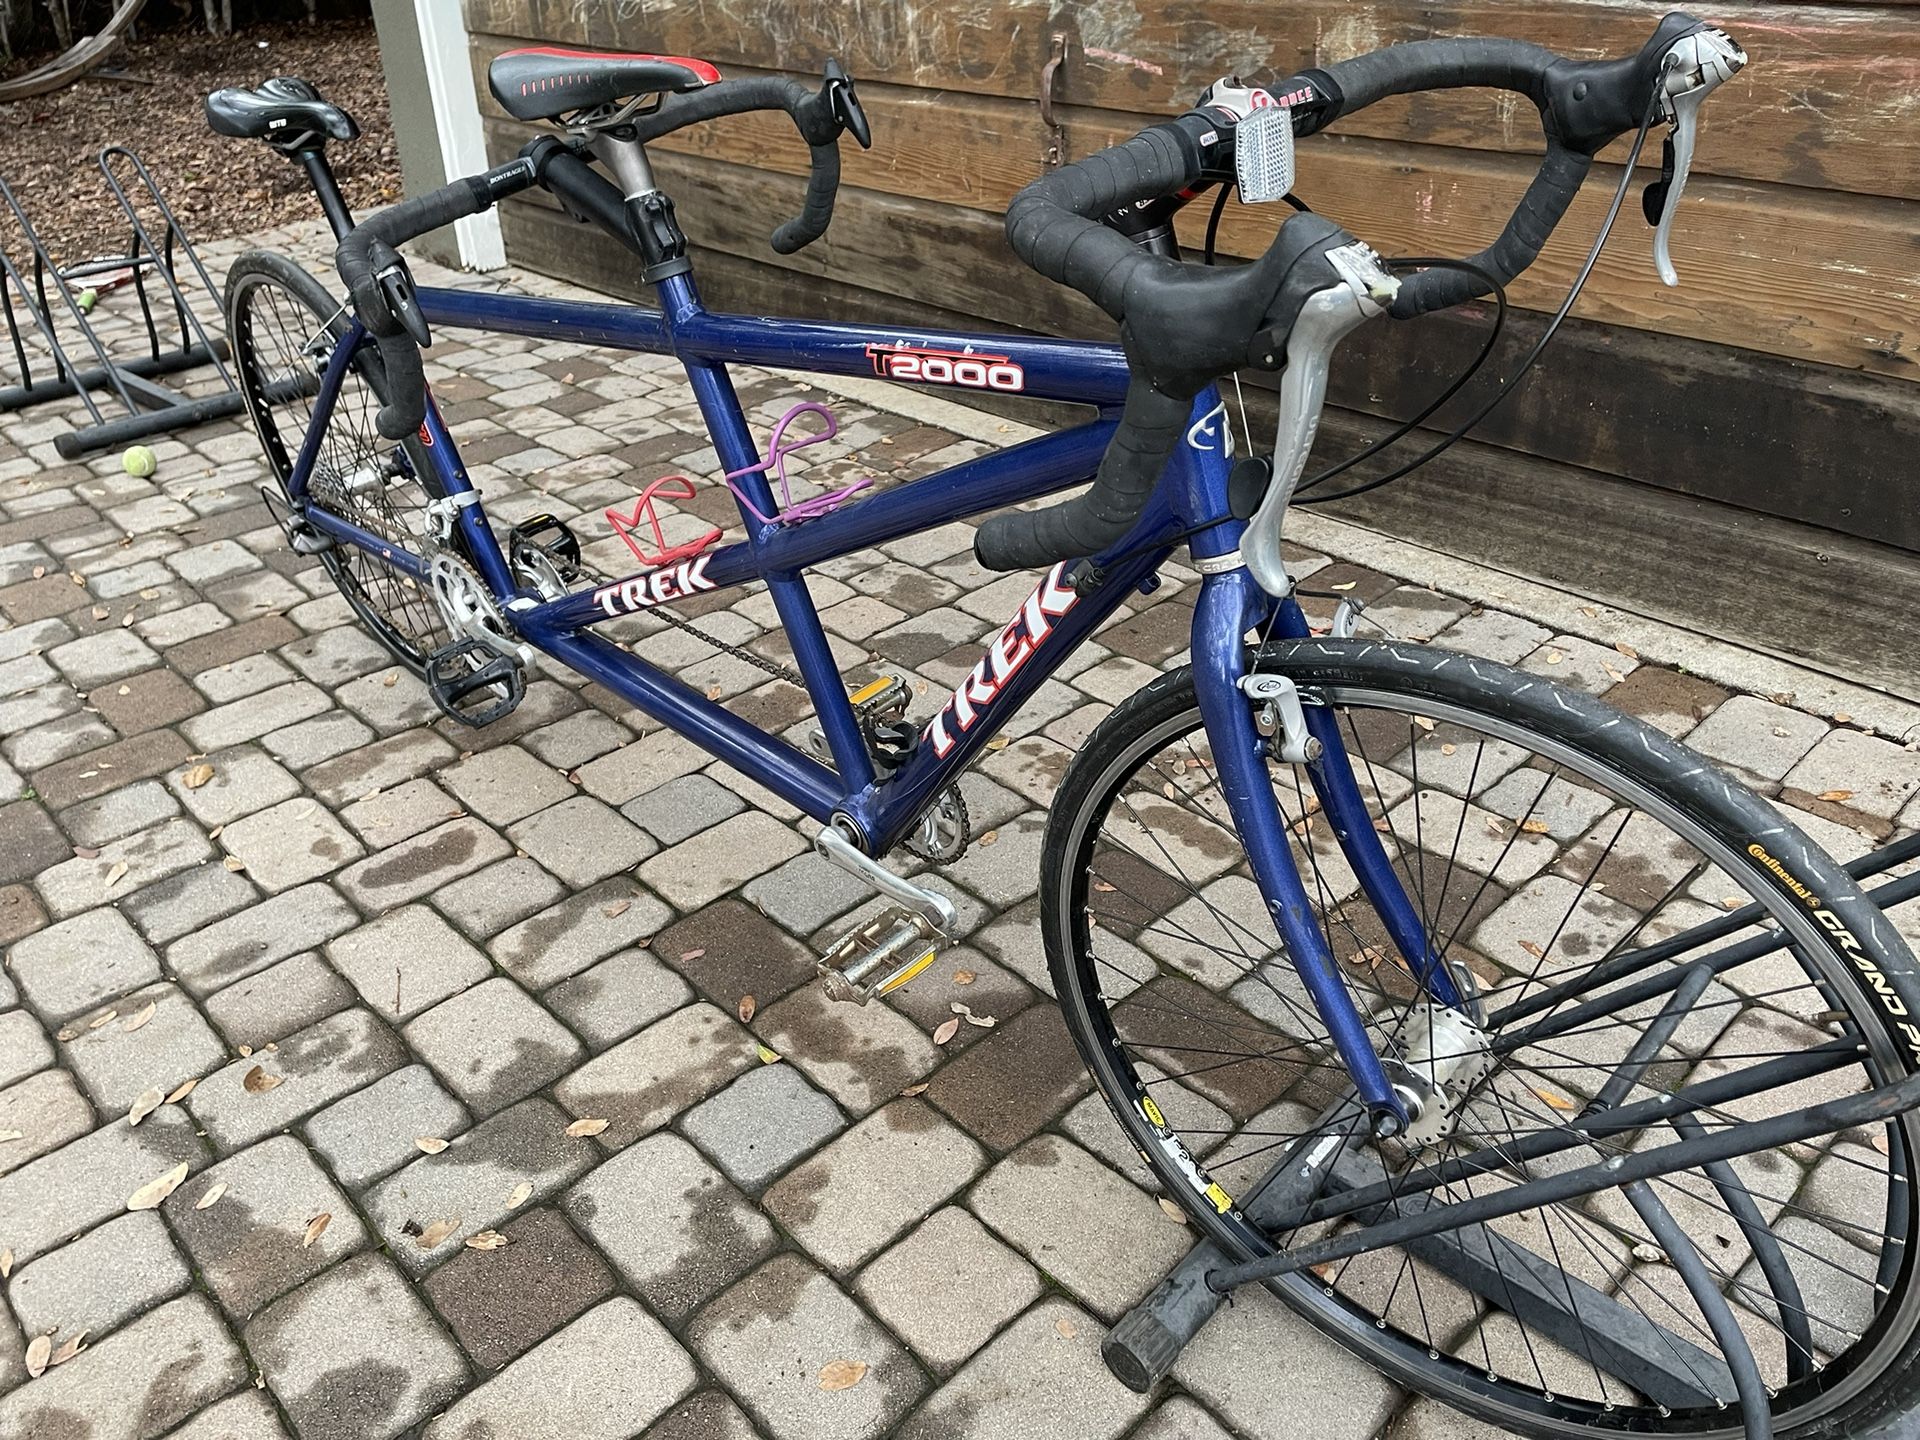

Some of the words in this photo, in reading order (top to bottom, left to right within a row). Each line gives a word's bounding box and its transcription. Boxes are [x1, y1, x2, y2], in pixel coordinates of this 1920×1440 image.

[865, 342, 1024, 392] T2000
[592, 553, 719, 617] TREK
[920, 559, 1090, 760] TREK
[1748, 843, 1812, 900] Continental
[1813, 909, 1908, 1016] GRAND
[1146, 1102, 1161, 1123] MAVIC
